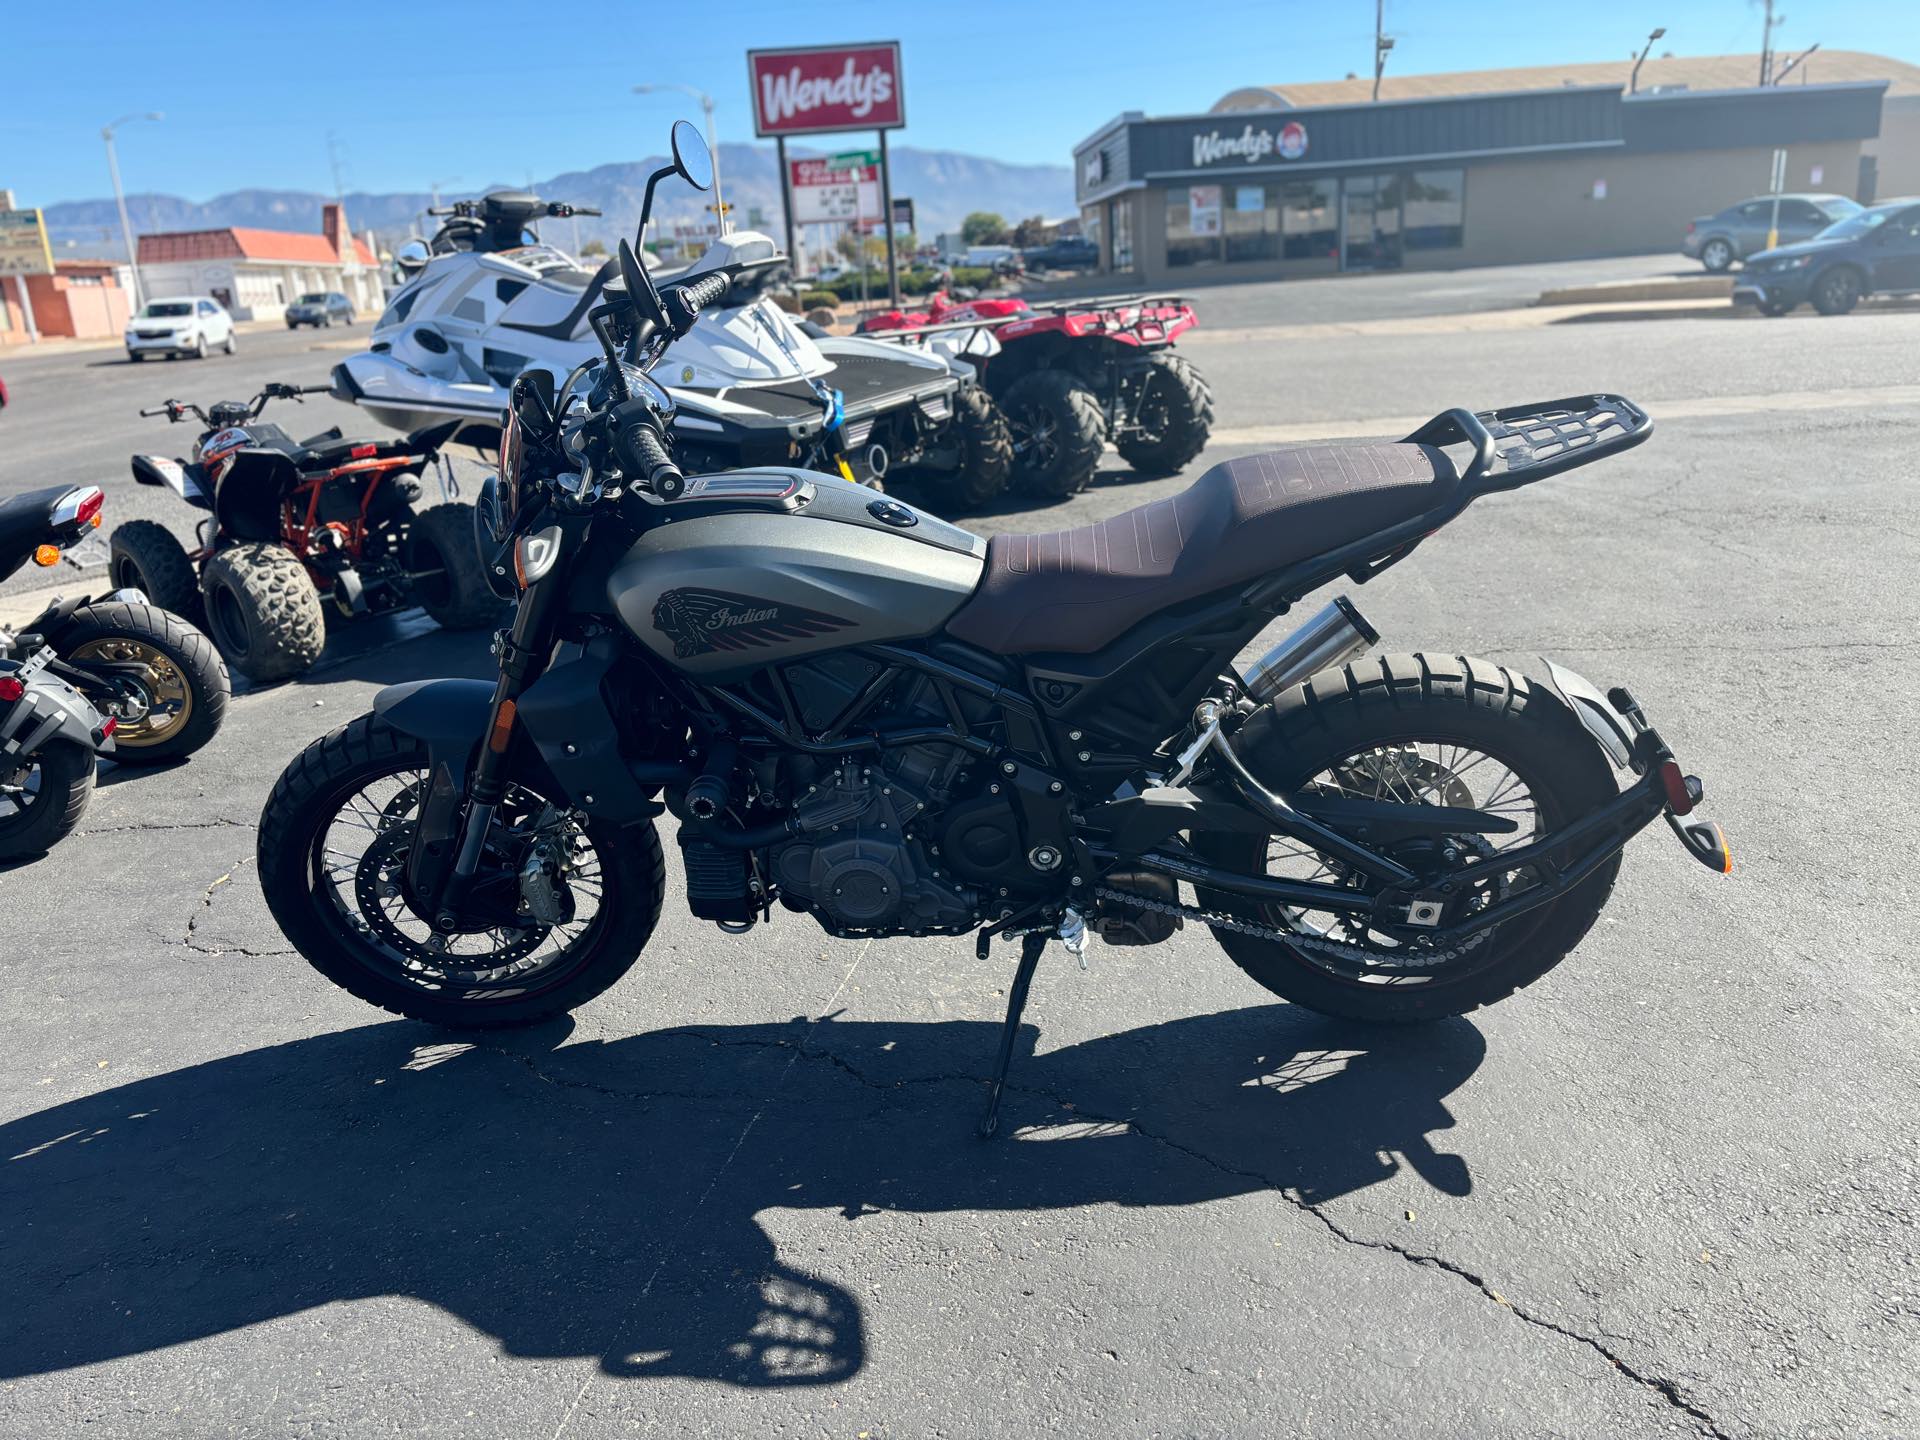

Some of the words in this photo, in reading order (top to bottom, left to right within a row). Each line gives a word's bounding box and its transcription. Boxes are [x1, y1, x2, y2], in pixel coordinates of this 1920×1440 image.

[761, 57, 893, 124] Wendy's
[1193, 125, 1272, 167] Wendy's
[705, 607, 778, 630] Indian
